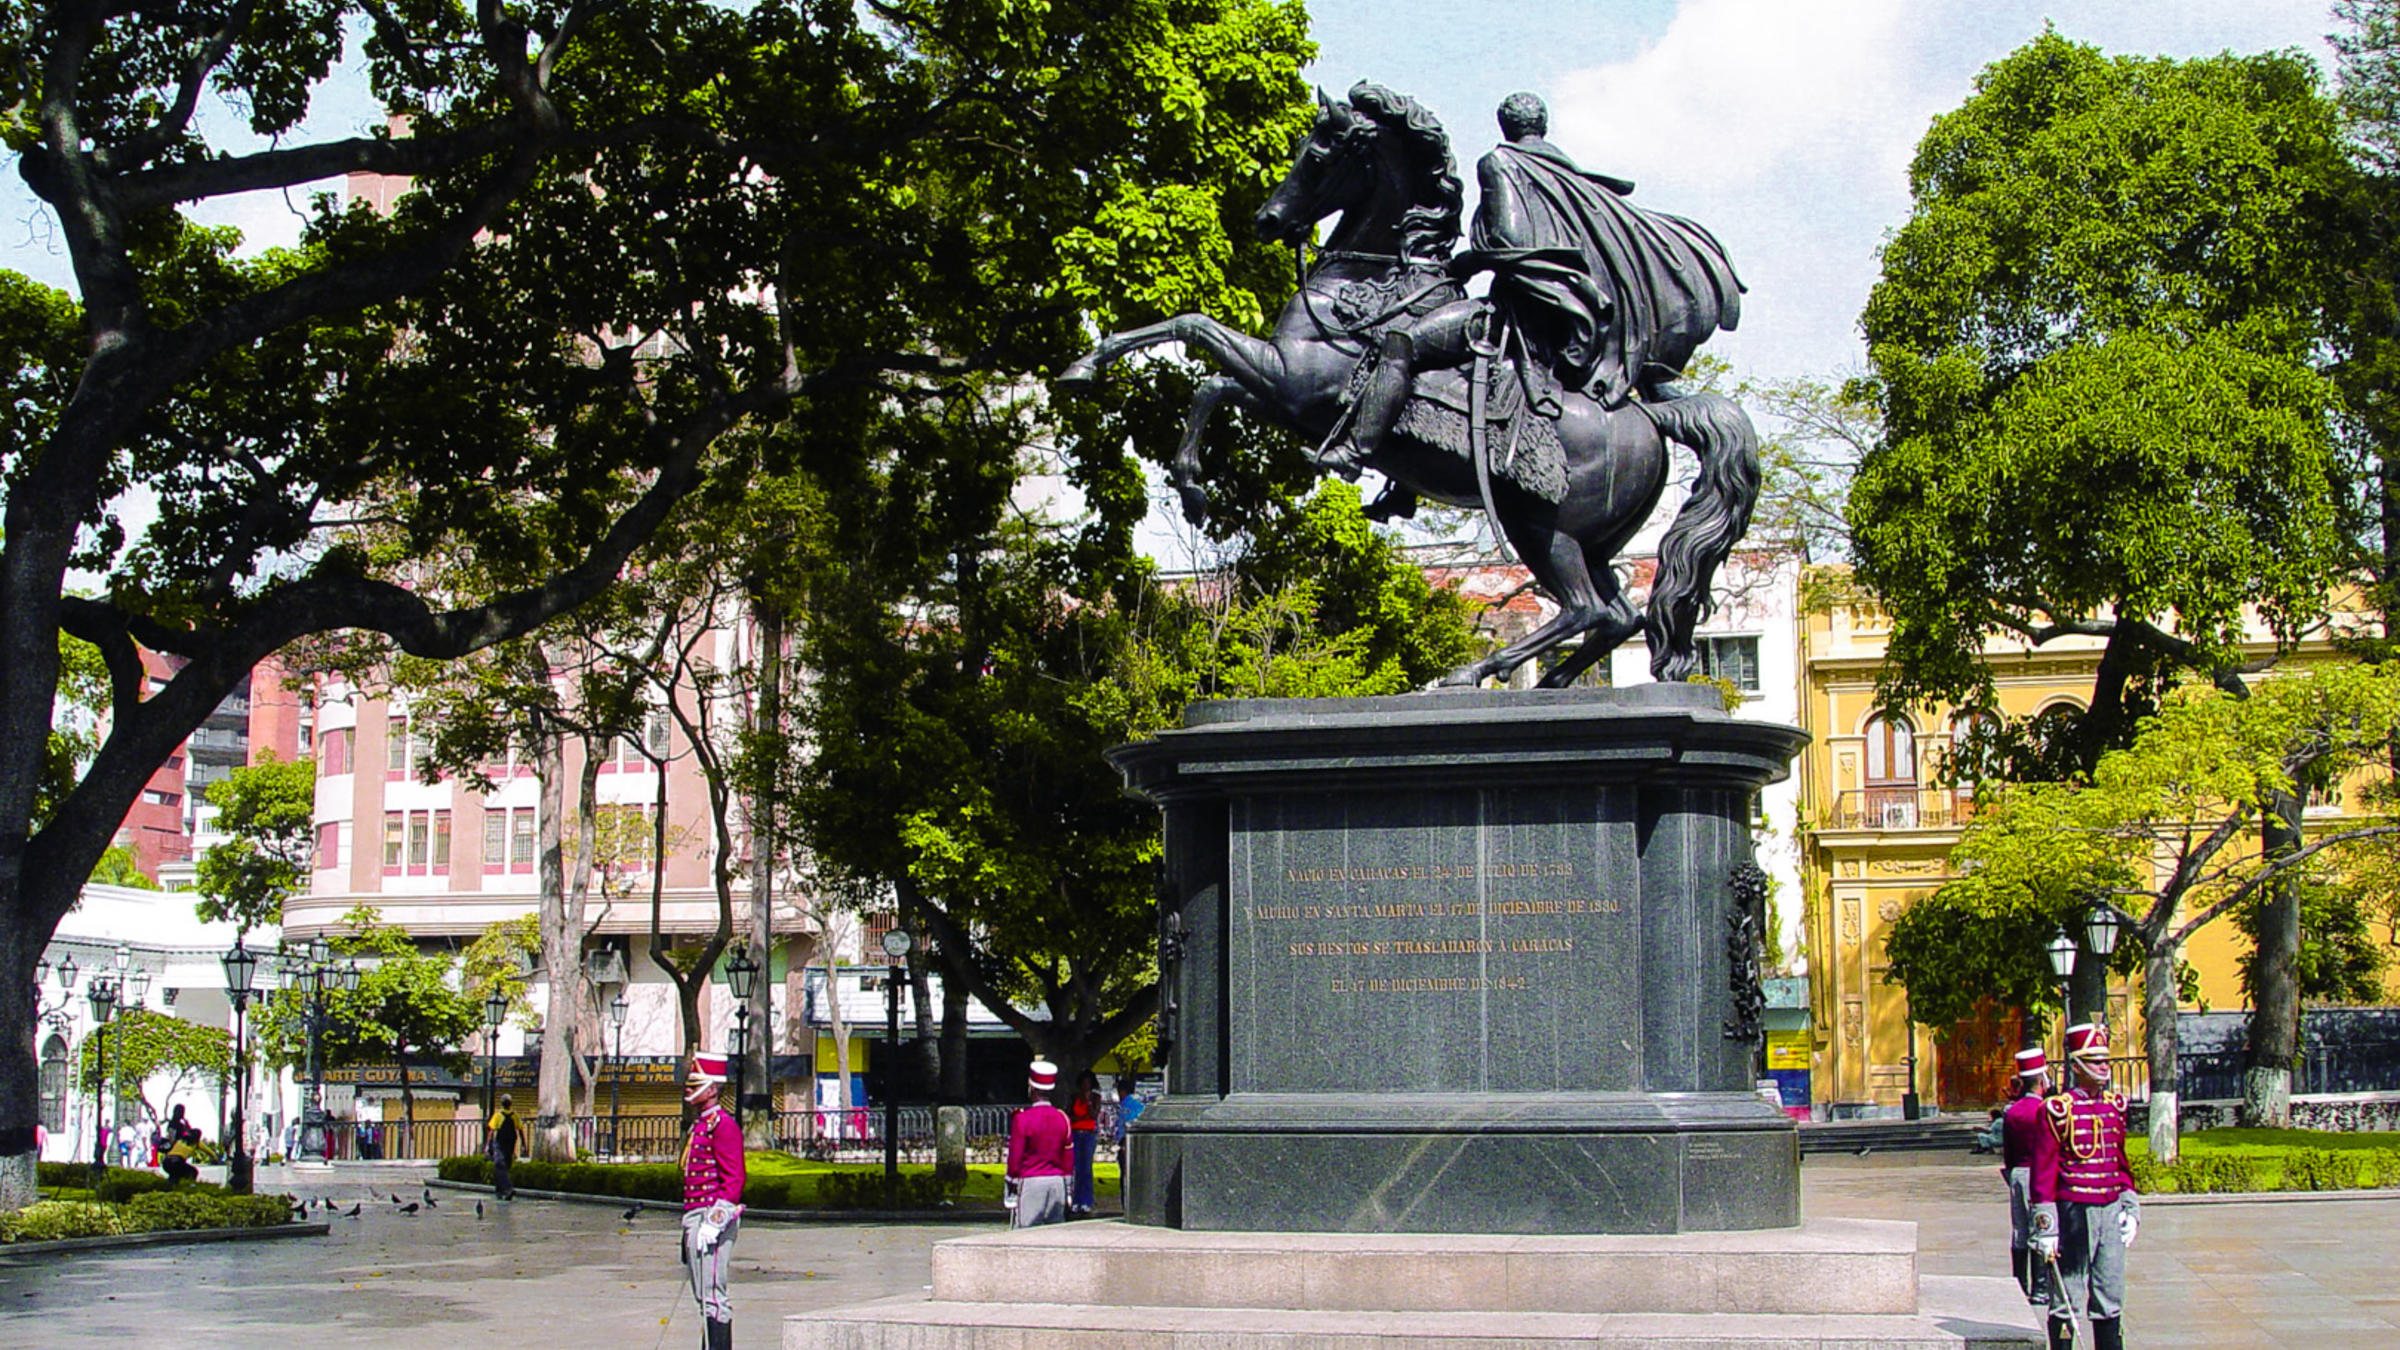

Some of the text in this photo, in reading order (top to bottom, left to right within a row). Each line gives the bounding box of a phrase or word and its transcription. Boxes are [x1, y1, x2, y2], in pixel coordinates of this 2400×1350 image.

[1329, 867, 1346, 881] EN
[1350, 866, 1409, 881] CARACAS
[1413, 865, 1428, 880] EL
[1435, 865, 1451, 880] 24
[1456, 865, 1475, 879] DE
[1520, 863, 1539, 877] DE
[1257, 905, 1300, 920] MURIO
[1304, 904, 1321, 919] EN
[1325, 904, 1371, 919] SANTA
[1375, 903, 1425, 918] MARTA
[1429, 903, 1446, 917] EL
[1450, 903, 1463, 916] 17
[1466, 902, 1483, 916] DE
[1489, 900, 1563, 915] DICIEMBRE
[1567, 900, 1585, 914] DE
[1289, 938, 1574, 956] SUS RESTOS SE TRASLADARON A CARACAS
[1331, 978, 1349, 993] EL
[1352, 978, 1365, 993] 17
[1368, 977, 1388, 992] DE
[1391, 977, 1467, 992] DICIEMBRE
[1470, 976, 1489, 991] DE
[323, 1069, 360, 1083] ARTE
